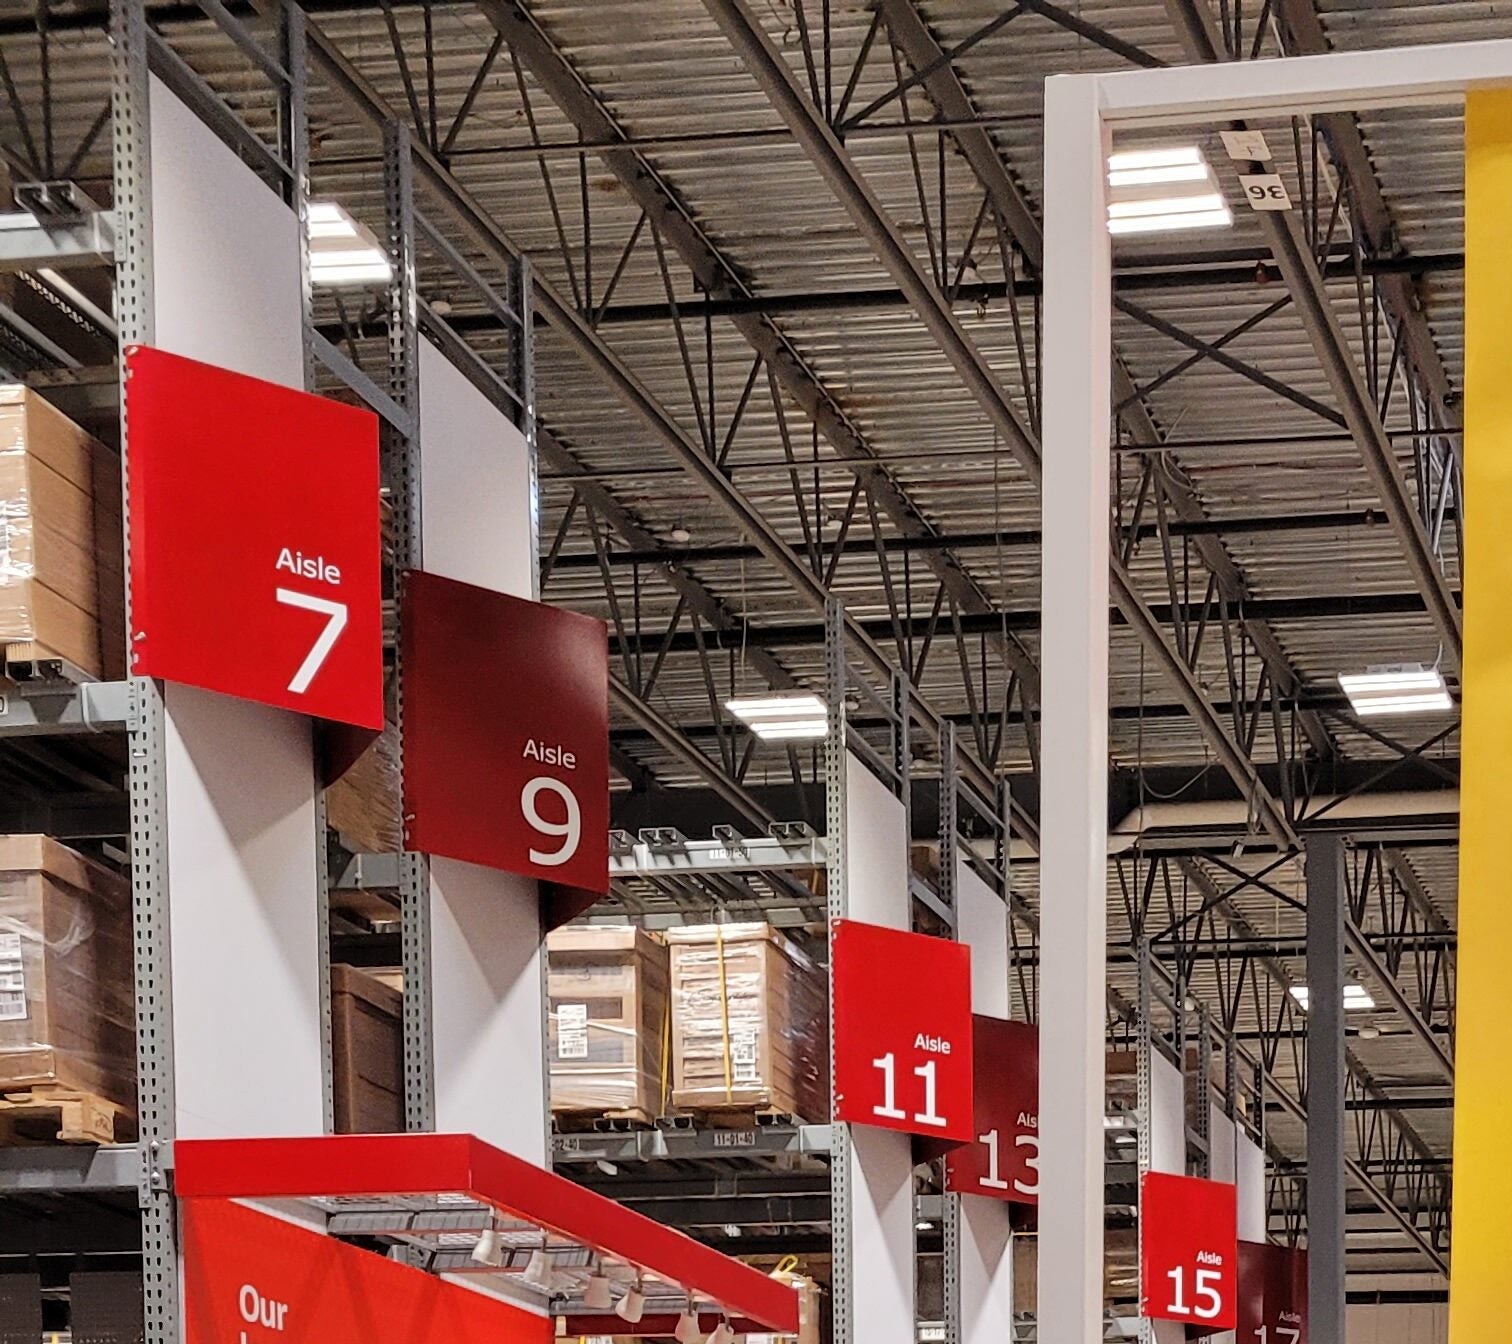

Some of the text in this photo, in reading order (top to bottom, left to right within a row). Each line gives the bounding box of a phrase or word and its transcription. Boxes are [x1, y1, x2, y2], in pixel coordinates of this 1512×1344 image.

[275, 547, 341, 585] Aisle
[276, 587, 347, 694] 7
[522, 739, 577, 770] Aisle
[520, 776, 582, 866] 9
[914, 1033, 950, 1054] Aisle
[873, 1052, 947, 1127] 11
[1017, 1112, 1038, 1128] Ais
[979, 1129, 1039, 1195] 13
[1196, 1250, 1222, 1266] Aisle
[239, 1284, 288, 1330] Our
[1167, 1265, 1221, 1318] 15
[1278, 1310, 1301, 1323] Aisle
